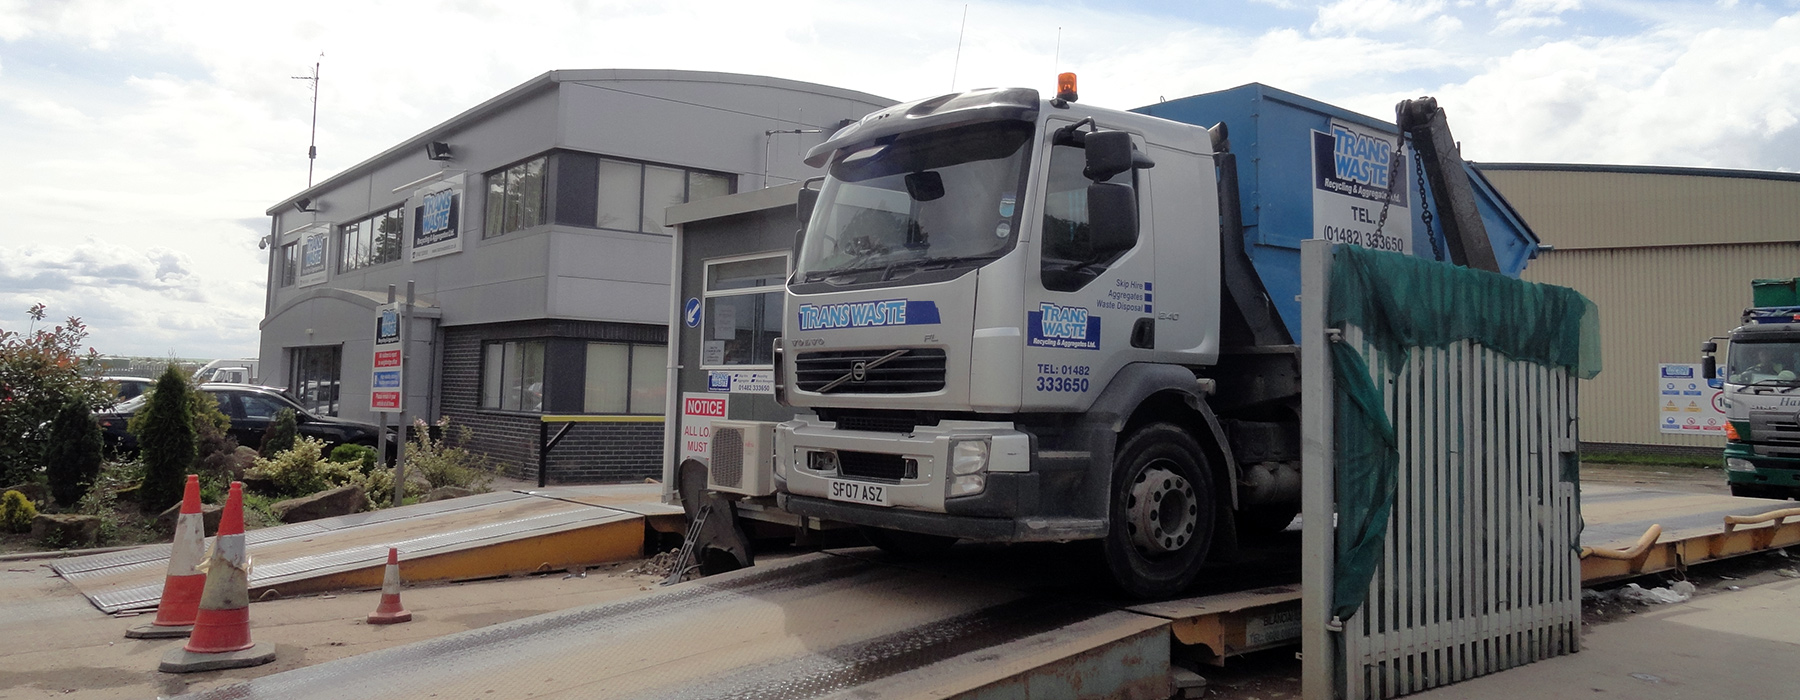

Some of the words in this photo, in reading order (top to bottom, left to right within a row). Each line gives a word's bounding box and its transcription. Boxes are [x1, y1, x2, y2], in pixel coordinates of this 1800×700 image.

[1333, 127, 1390, 165] TRANS
[1335, 154, 1388, 188] WASTE
[1324, 178, 1352, 195] Recycling
[1353, 185, 1357, 193] &
[1358, 186, 1389, 200] Aggregate
[423, 190, 452, 216] TRANS
[423, 210, 450, 235] WASTE
[1351, 206, 1376, 224] TEL.
[1323, 225, 1362, 246] (01482)
[1365, 232, 1404, 252] 333650
[1115, 278, 1129, 289] Skip
[1131, 281, 1143, 290] Hire
[1108, 289, 1143, 301] Aggregates
[800, 303, 850, 330] TRANS
[850, 300, 907, 327] WASTE
[1040, 303, 1088, 323] TRANS
[1096, 299, 1116, 310] Waste
[1117, 301, 1143, 313] Disposal
[1042, 321, 1087, 340] WASTE
[791, 338, 825, 347] VOLVO
[1033, 337, 1056, 348] Recycling
[1061, 339, 1087, 349] Aggregates
[1037, 364, 1059, 375] TEL:
[1061, 365, 1090, 376] 01482
[1036, 377, 1089, 392] 333650
[687, 399, 723, 415] NOTICE
[684, 426, 697, 437] ALL
[699, 427, 710, 438] LO
[686, 441, 708, 453] MUST
[832, 481, 858, 498] SF07
[862, 485, 883, 502] ASZ
